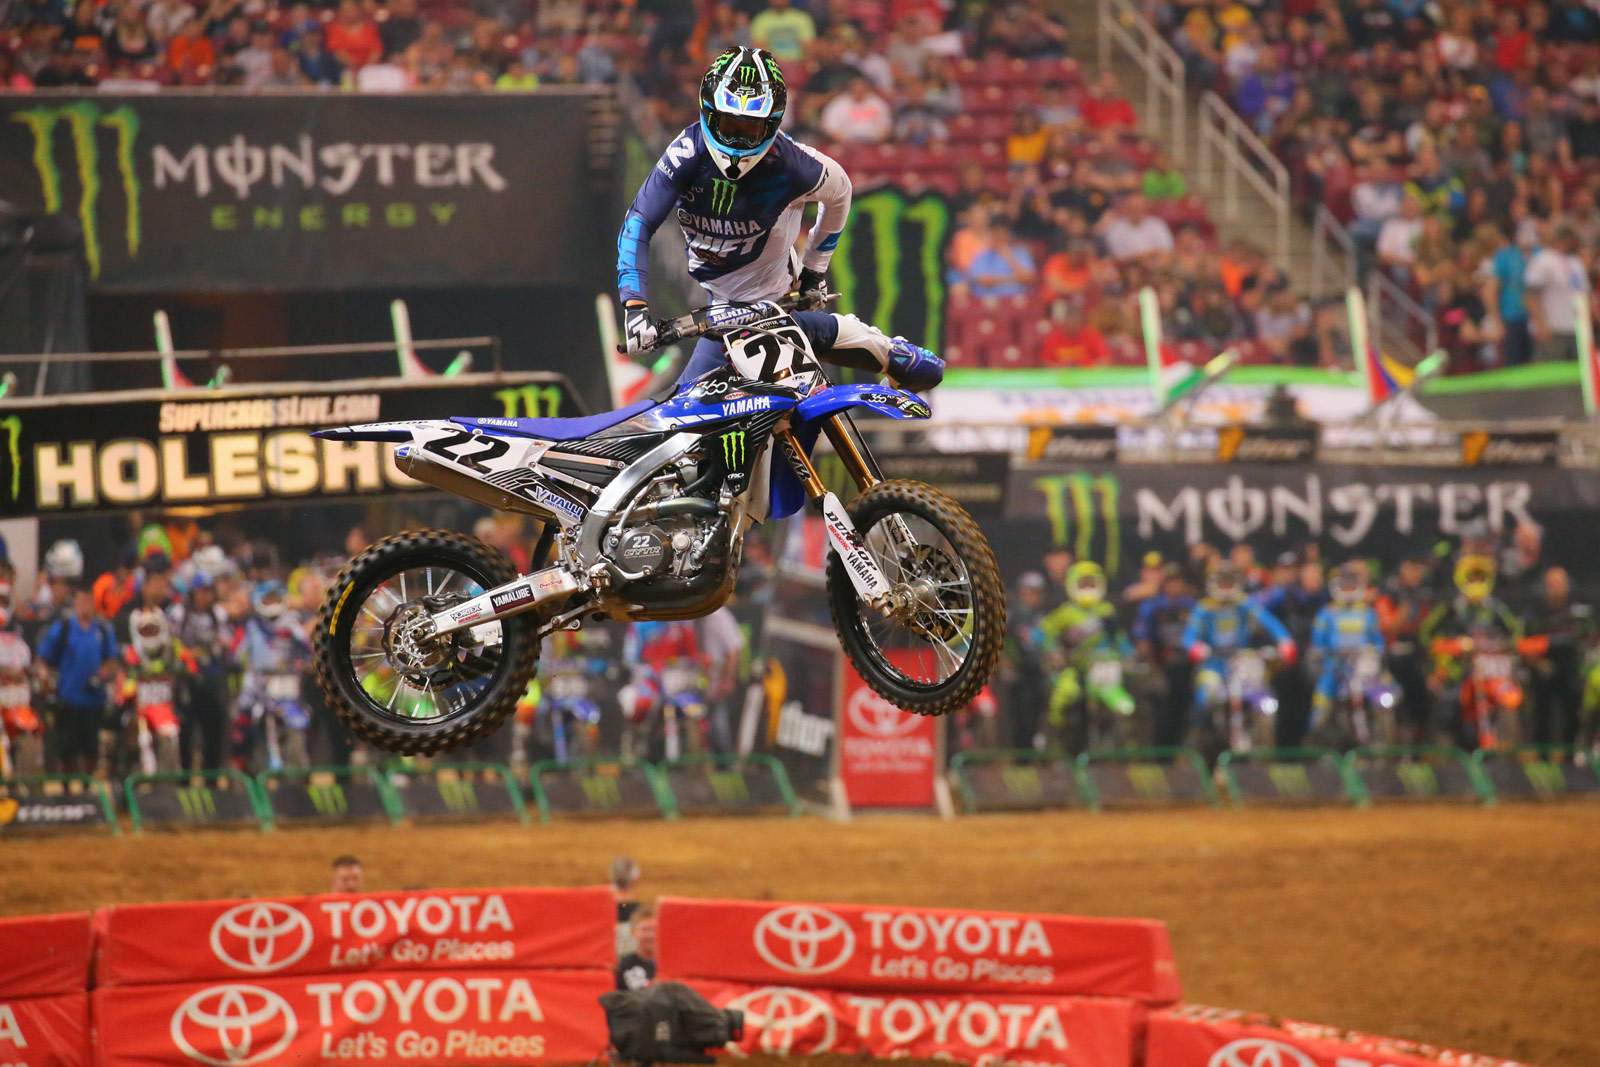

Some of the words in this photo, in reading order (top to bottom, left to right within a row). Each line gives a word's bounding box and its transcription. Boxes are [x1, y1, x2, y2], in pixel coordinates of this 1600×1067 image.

[152, 134, 507, 199] MONSTER
[211, 202, 456, 230] ENERGY
[693, 215, 762, 236] YAMAHA
[744, 329, 818, 383] 22
[722, 396, 771, 417] YAMAHA
[487, 418, 518, 428] YAMAHA
[423, 427, 510, 474] 22
[550, 494, 582, 516] VALLI
[1135, 474, 1536, 547] MONSTER
[632, 535, 650, 548] 22
[828, 524, 850, 551] BRAKING
[846, 552, 878, 590] YAMAHA
[493, 587, 531, 607] YAMALUBE
[321, 895, 514, 939] TOYOTA
[862, 911, 1054, 957] TOYOTA
[329, 943, 385, 967] Let's
[391, 939, 429, 962] Go
[431, 938, 515, 962] Places
[870, 954, 928, 978] Let's
[932, 956, 970, 980] Go
[971, 957, 1055, 984] Places
[305, 977, 545, 1028] TOYOTA
[849, 996, 1069, 1050] TOYOTA
[321, 1031, 389, 1060] Let's
[395, 1029, 440, 1058] Go
[445, 1029, 546, 1058] Places
